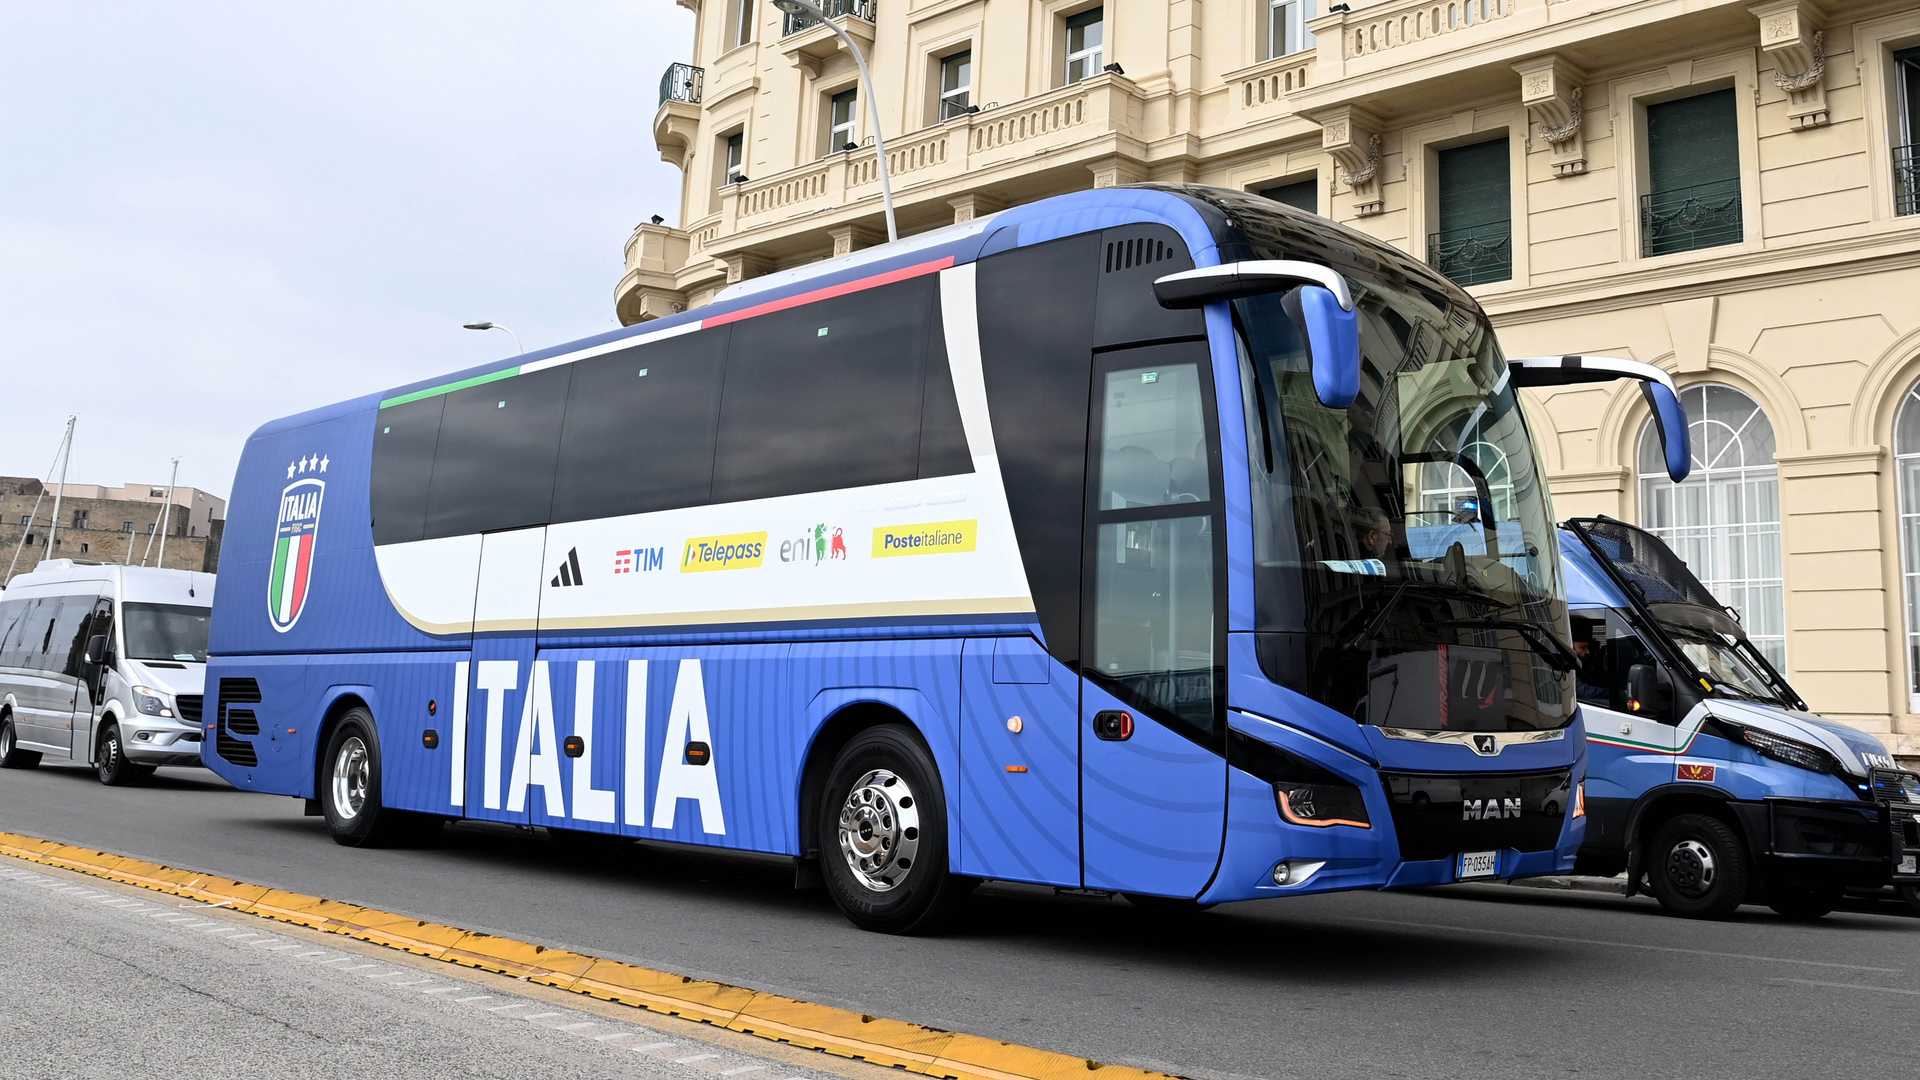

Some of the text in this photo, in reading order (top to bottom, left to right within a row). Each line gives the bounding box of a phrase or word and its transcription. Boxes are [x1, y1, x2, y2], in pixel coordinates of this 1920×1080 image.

[281, 491, 317, 522] ITALIA
[698, 540, 762, 566] Telepass
[779, 528, 811, 563] eni
[884, 530, 962, 549] Posteitaliane
[634, 546, 664, 573] TIM
[451, 658, 726, 836] ITALIA
[1462, 797, 1521, 821] MAN
